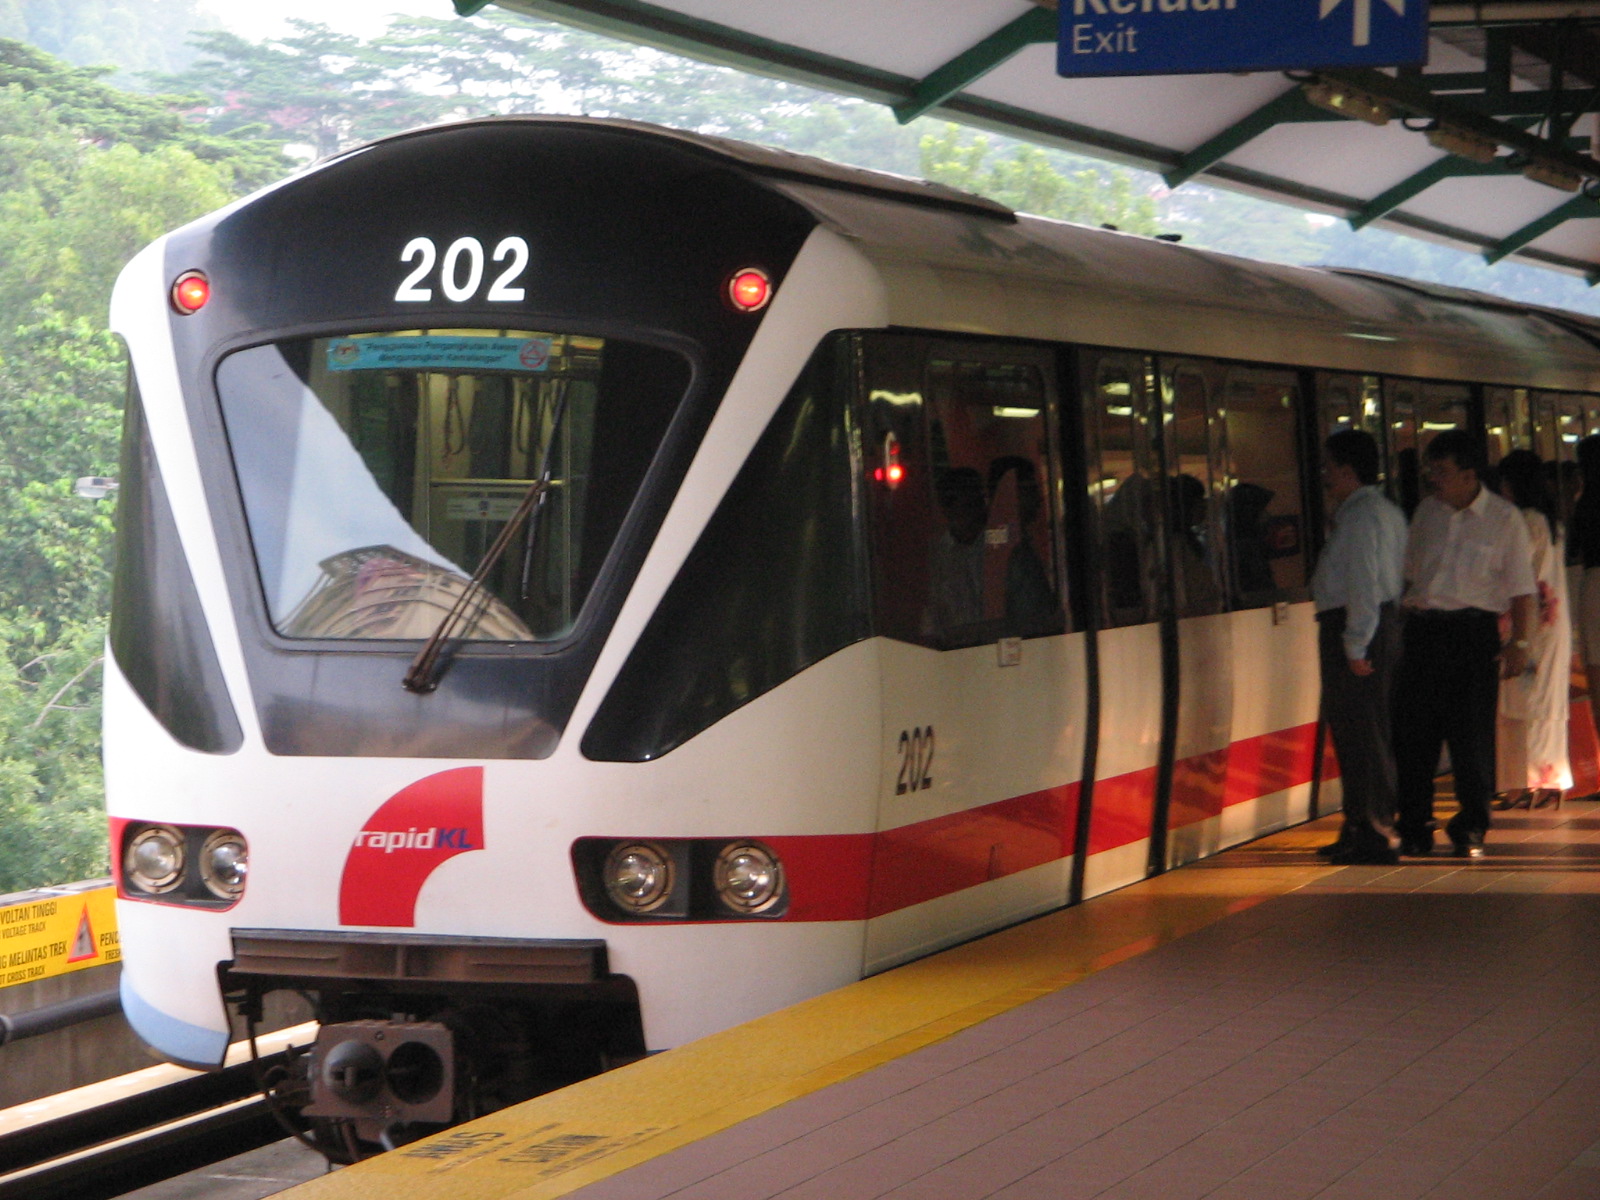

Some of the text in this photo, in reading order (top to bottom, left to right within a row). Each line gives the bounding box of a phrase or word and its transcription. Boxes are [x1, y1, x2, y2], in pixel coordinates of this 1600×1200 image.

[1073, 22, 1138, 54] Exit
[395, 236, 529, 302] 202
[896, 725, 935, 796] 202
[354, 827, 474, 854] rapidKL
[0, 901, 57, 925] VOLTAN TINGGI
[2, 921, 46, 939] VOLTAGE TRACK
[9, 945, 47, 967] MELINTAS
[50, 940, 67, 957] TREK
[7, 969, 26, 983] CROSS
[27, 965, 45, 978] TRACK
[400, 1131, 505, 1160] AWAS
